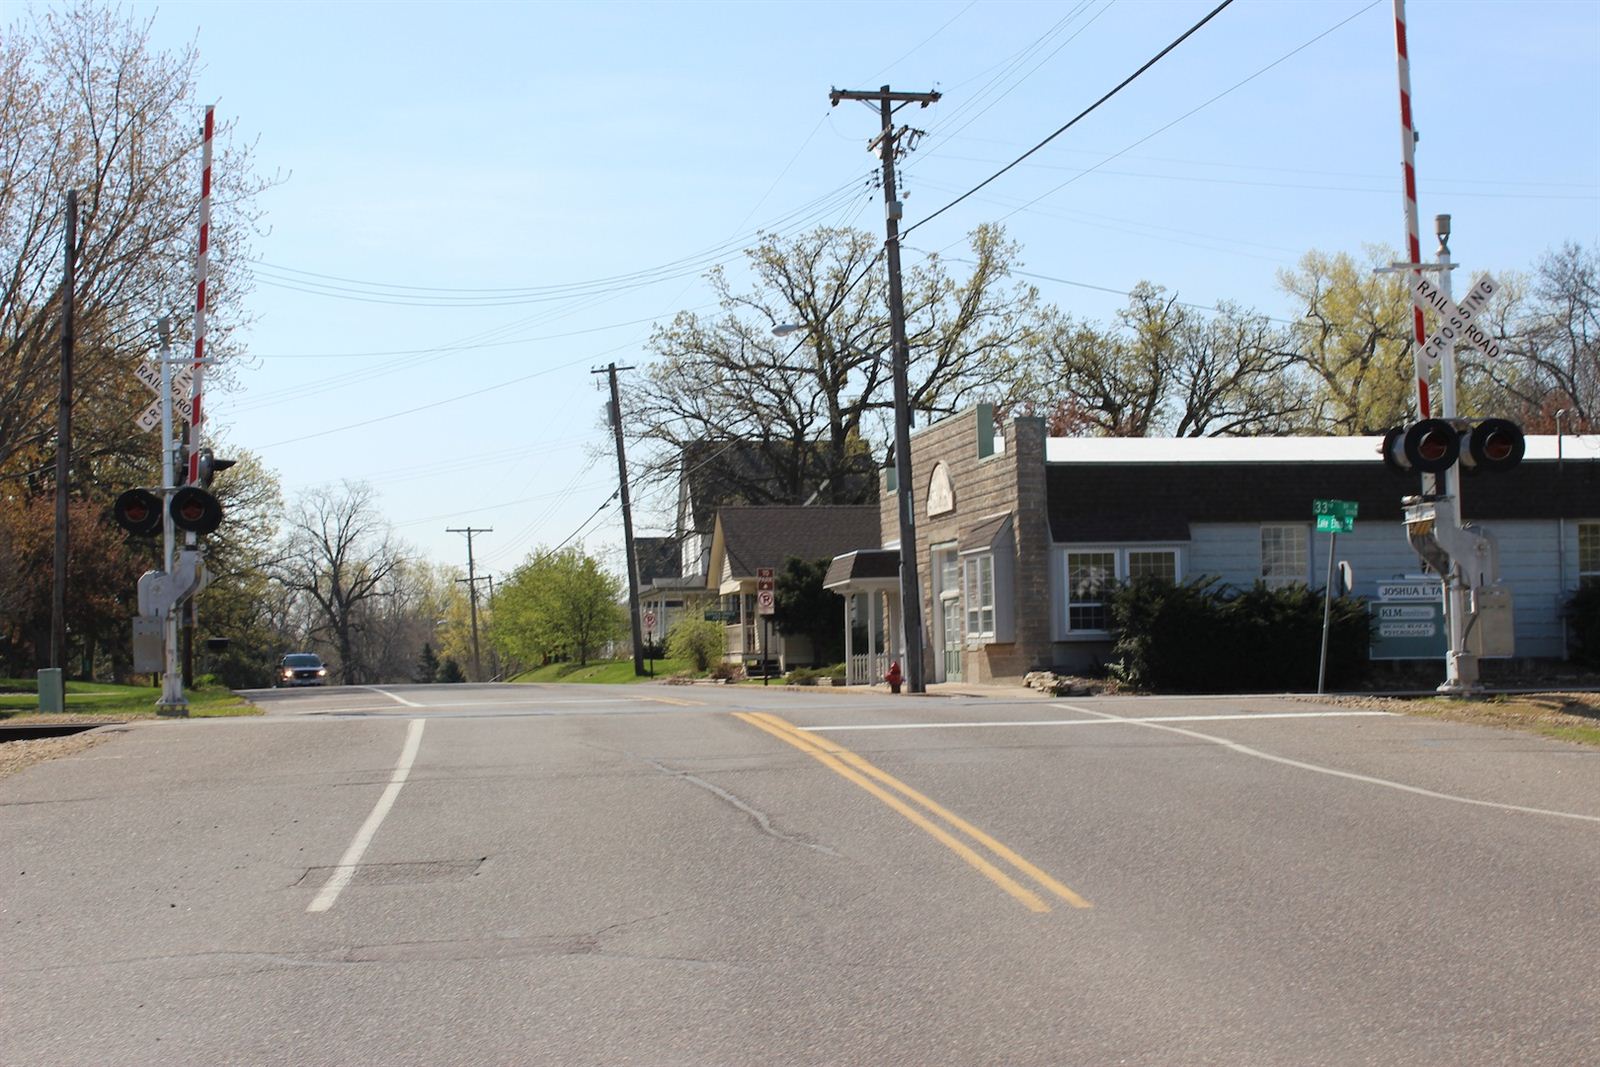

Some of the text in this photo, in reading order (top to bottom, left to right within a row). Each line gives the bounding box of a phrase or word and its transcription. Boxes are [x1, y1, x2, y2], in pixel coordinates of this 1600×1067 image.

[1417, 280, 1499, 358] RAIL ROAD
[1425, 281, 1493, 359] CROSSING
[1382, 587, 1420, 596] JOSHUA
